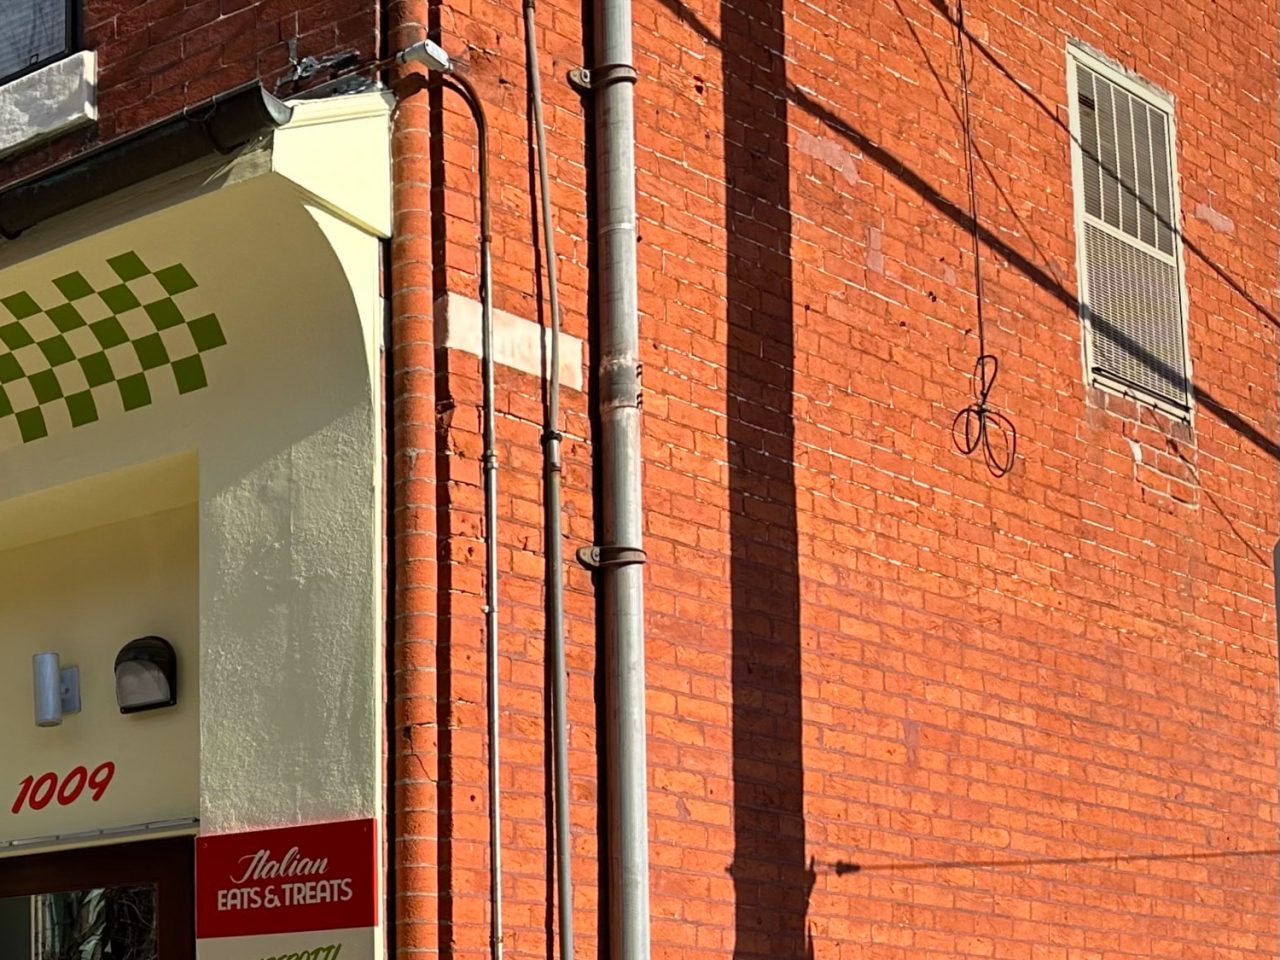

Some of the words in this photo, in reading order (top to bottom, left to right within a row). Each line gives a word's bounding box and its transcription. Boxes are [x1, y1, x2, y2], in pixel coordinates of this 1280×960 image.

[11, 761, 115, 814] 1009
[230, 846, 328, 884] Italian
[217, 887, 262, 911] EATS
[264, 885, 281, 908] &
[281, 878, 353, 906] TREATS
